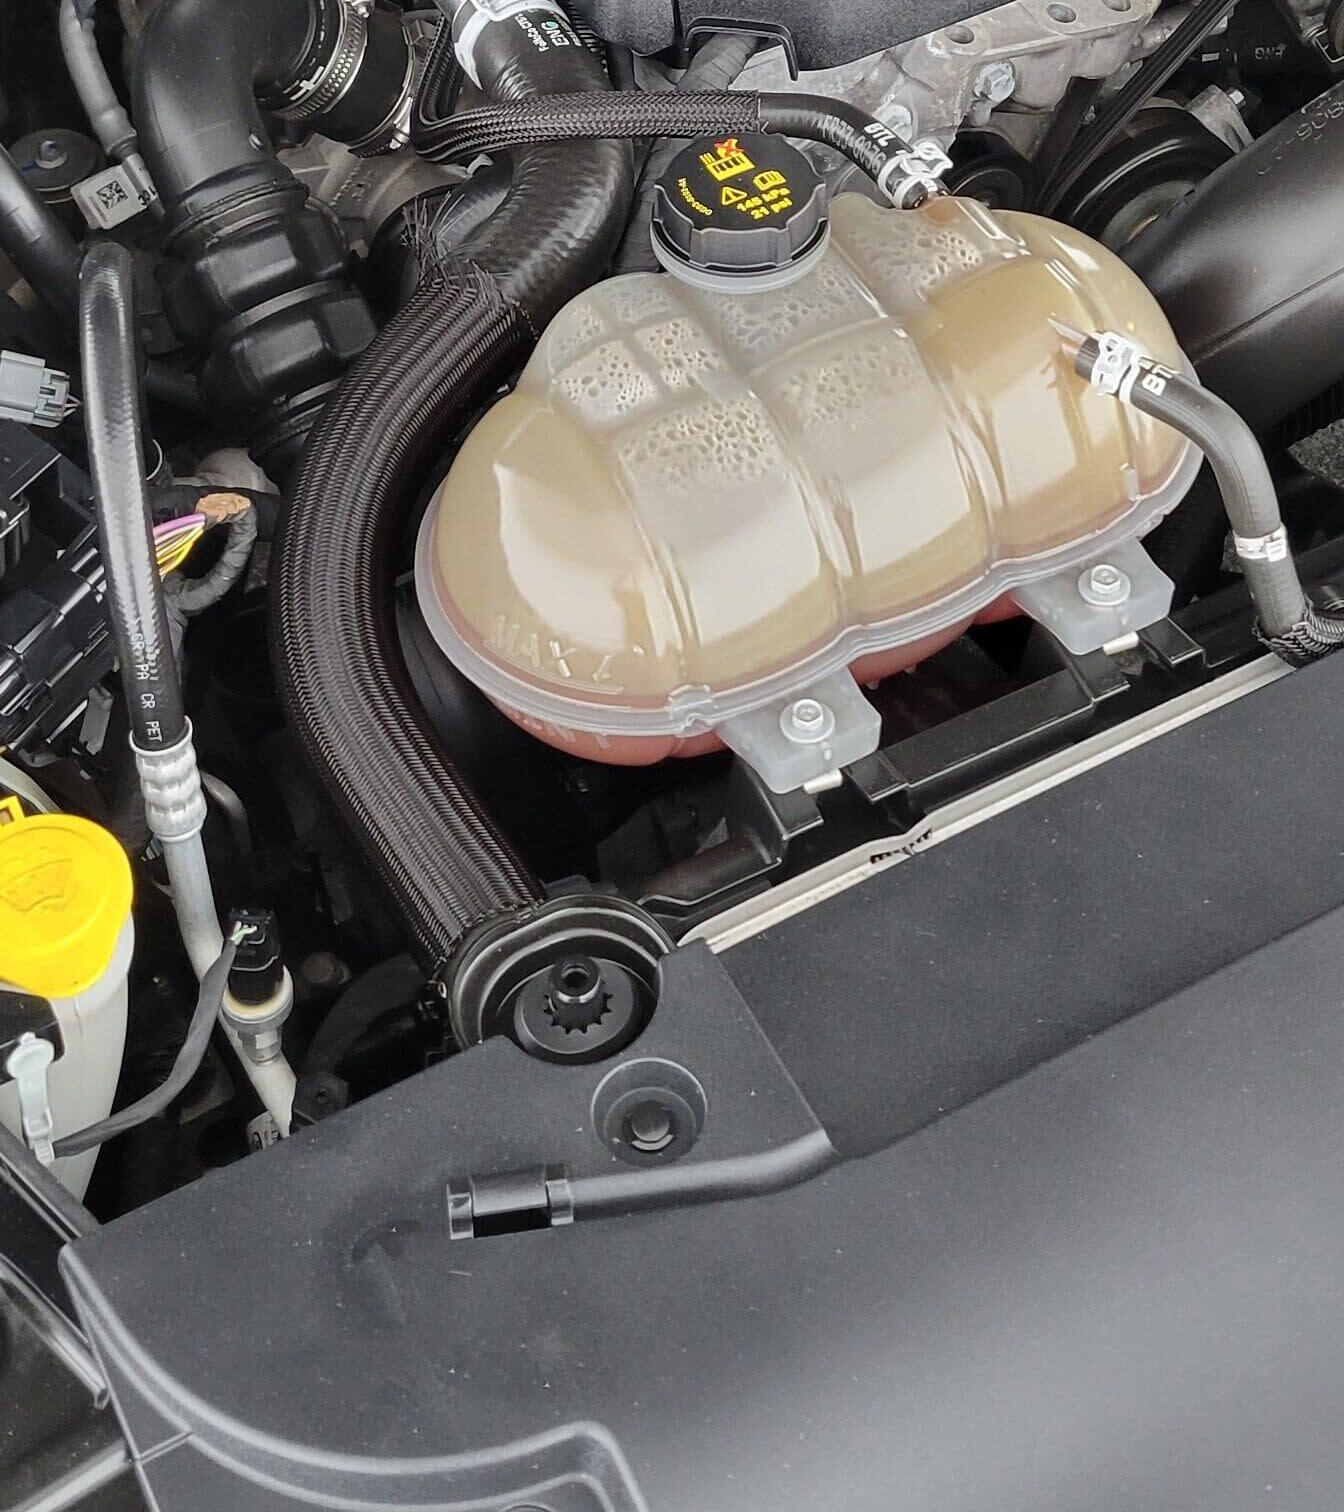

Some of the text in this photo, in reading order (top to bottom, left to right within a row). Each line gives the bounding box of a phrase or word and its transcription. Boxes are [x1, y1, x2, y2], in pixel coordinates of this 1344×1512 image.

[541, 20, 570, 47] ENG
[750, 206, 770, 220] 21
[141, 693, 155, 709] CR
[146, 720, 163, 742] PET
